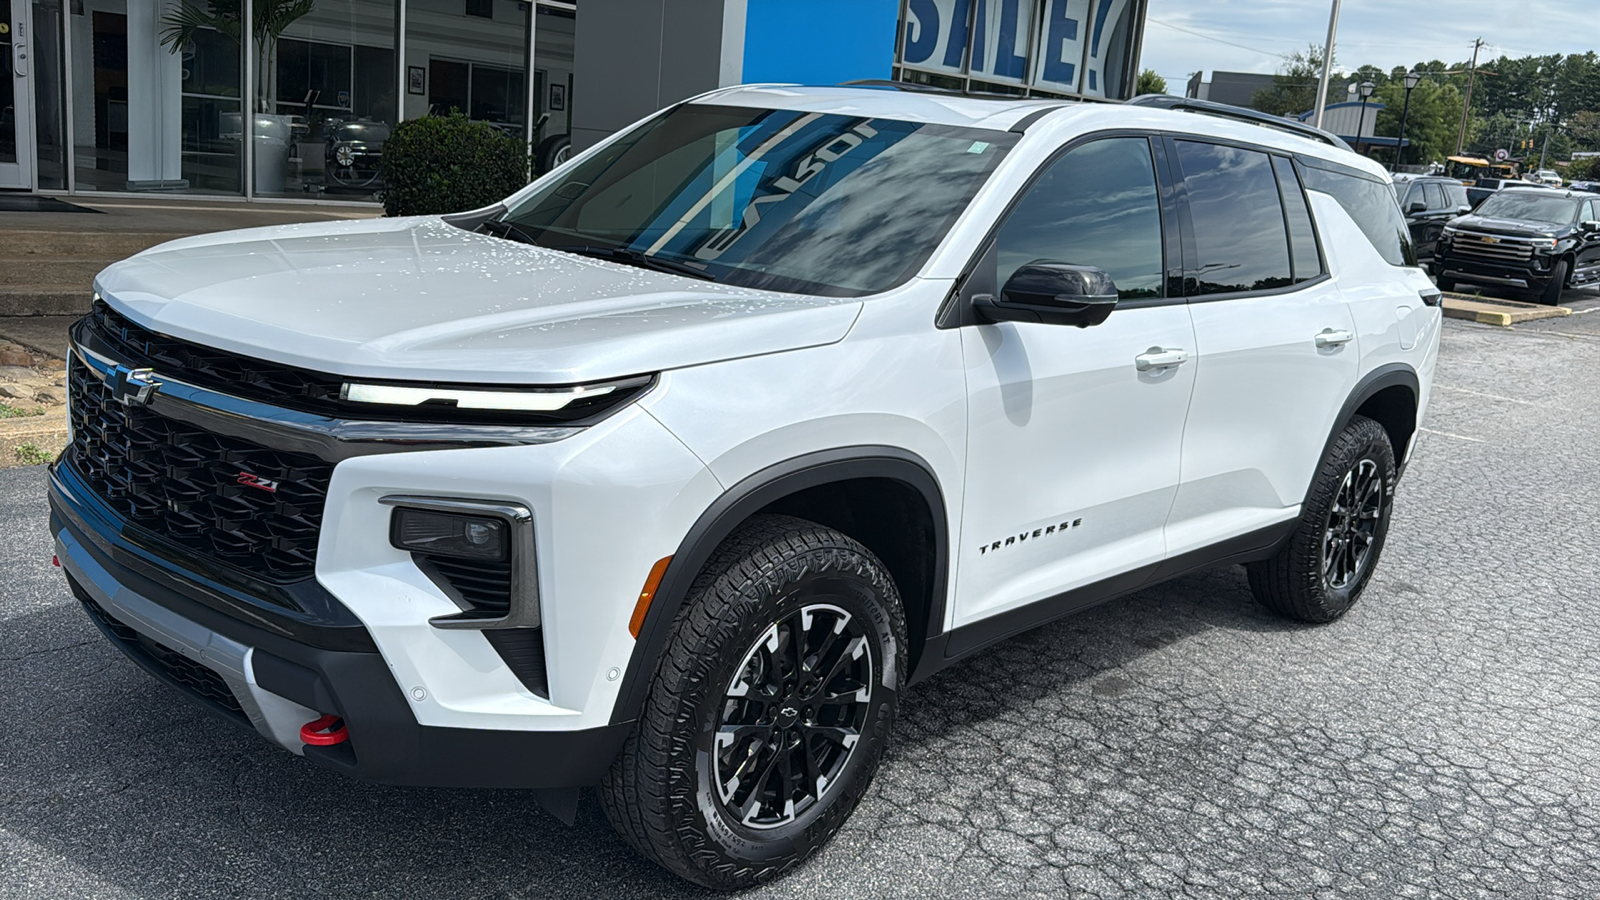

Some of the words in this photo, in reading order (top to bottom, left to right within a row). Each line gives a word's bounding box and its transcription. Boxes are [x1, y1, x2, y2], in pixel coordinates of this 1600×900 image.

[904, 0, 1114, 91] SALE!
[237, 471, 279, 492] Z71
[979, 518, 1082, 555] TRAVERSE
